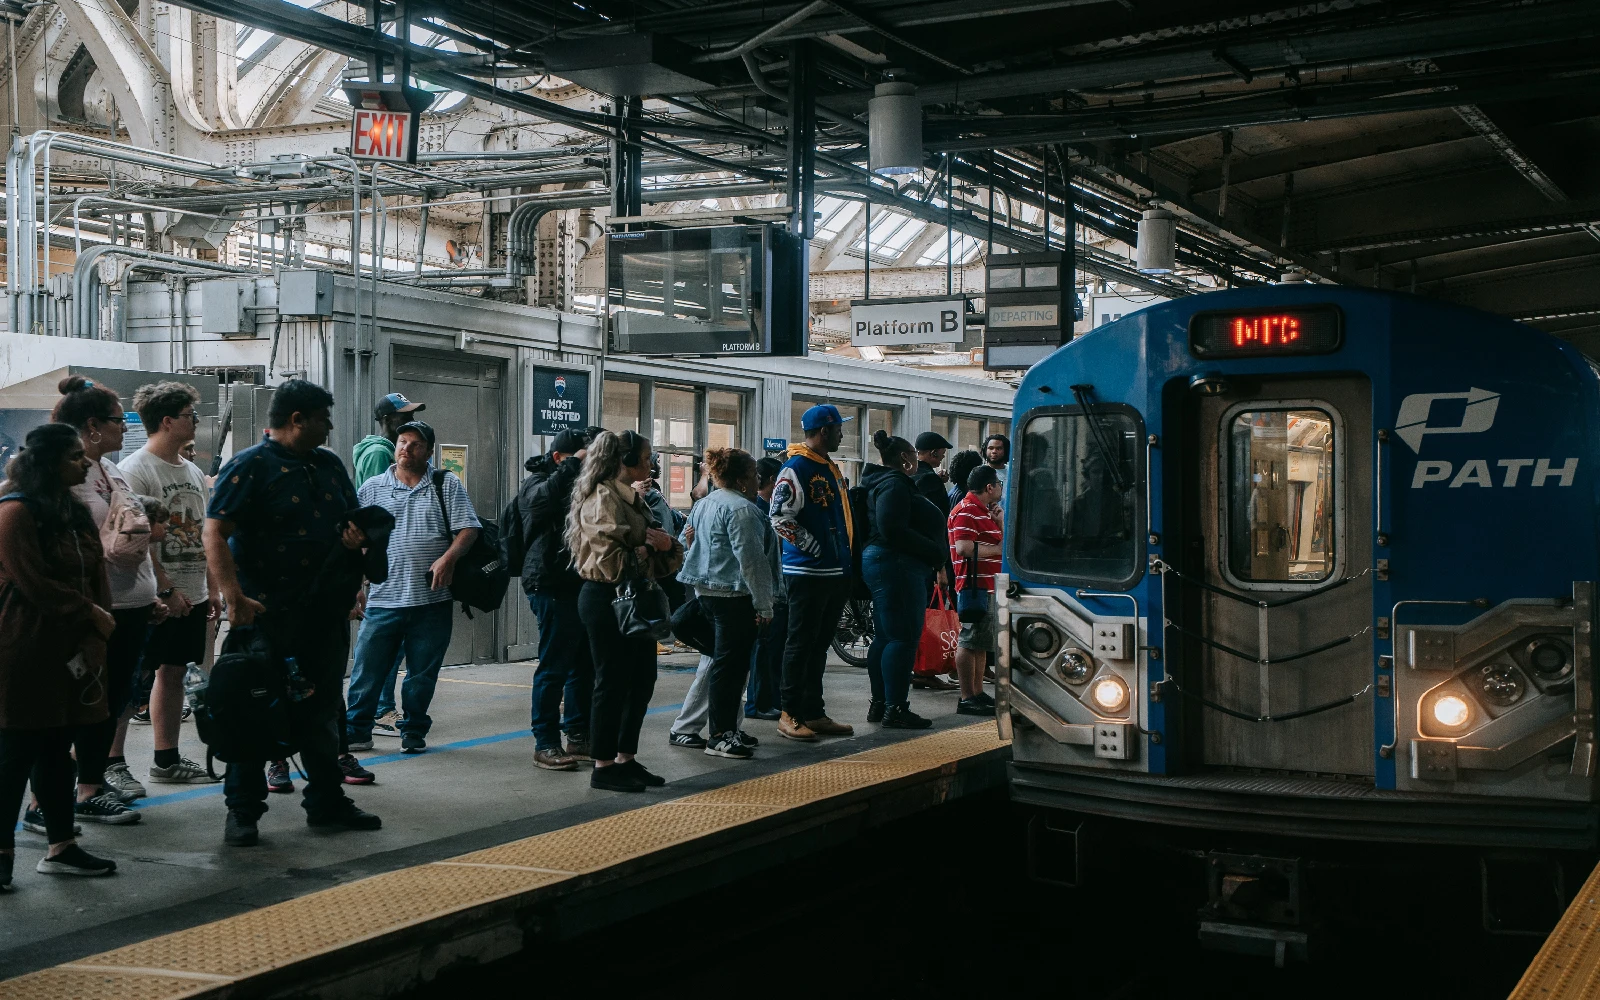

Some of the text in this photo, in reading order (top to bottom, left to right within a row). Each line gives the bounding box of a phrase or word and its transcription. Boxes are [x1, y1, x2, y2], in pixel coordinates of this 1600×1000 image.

[354, 112, 407, 157] EXIT
[992, 310, 1053, 322] DEPARTING
[856, 310, 959, 337] Platform B
[722, 342, 761, 351] PLATFORM B
[548, 398, 574, 410] MOST
[540, 409, 581, 421] TRUSTED
[1411, 457, 1579, 488] PATH
